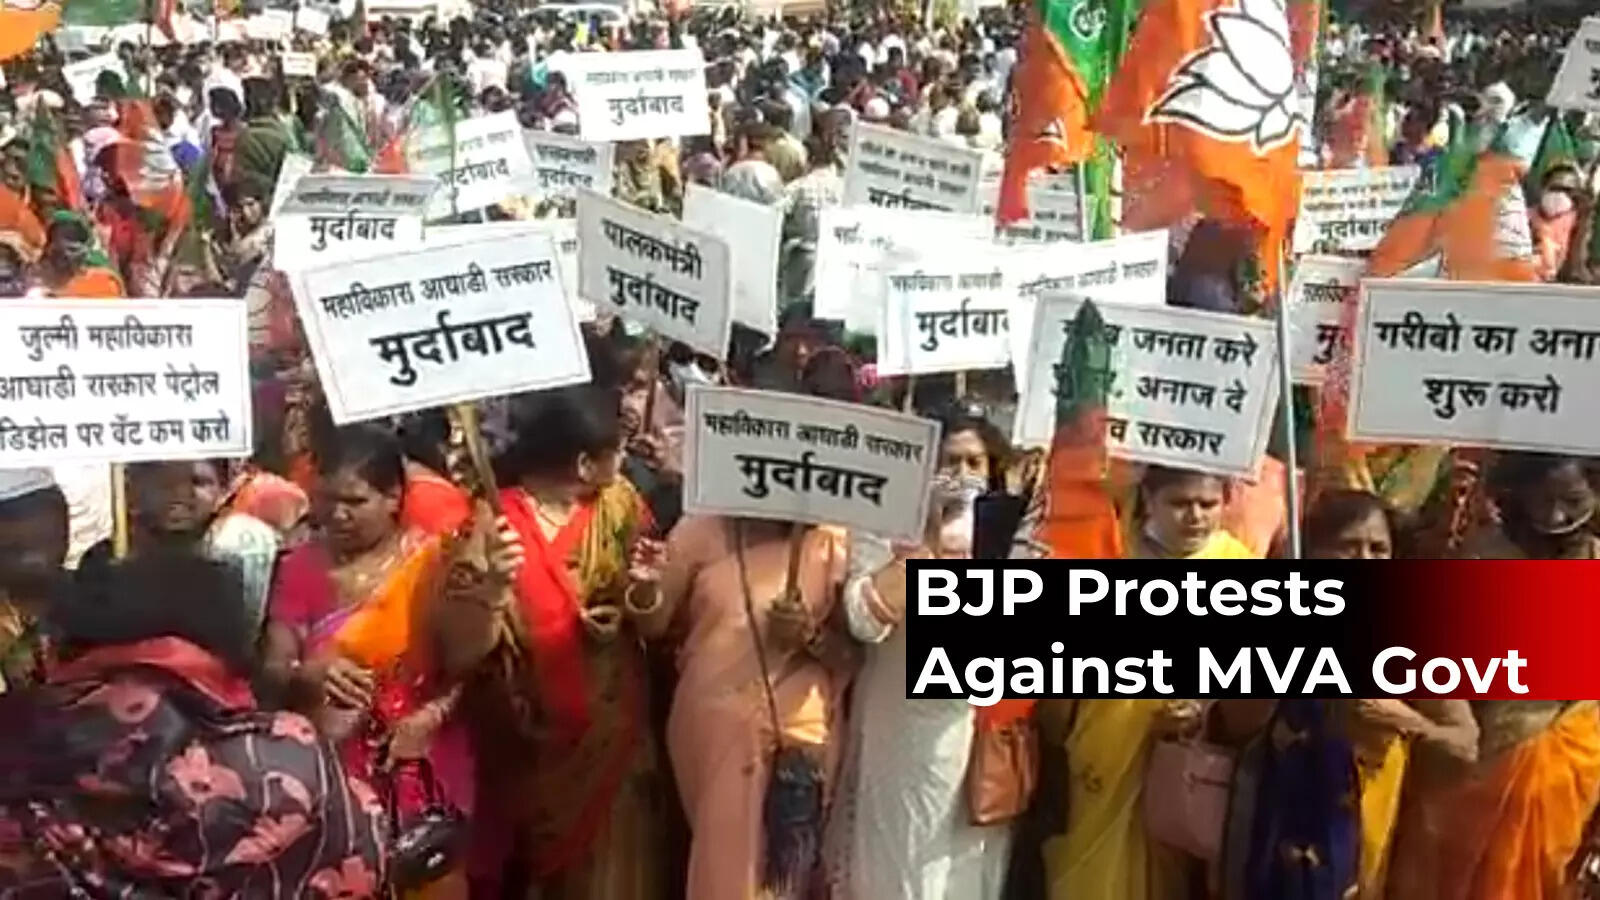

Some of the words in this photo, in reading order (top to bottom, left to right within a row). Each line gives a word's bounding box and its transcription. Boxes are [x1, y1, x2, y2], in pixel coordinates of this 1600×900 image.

[308, 208, 397, 251] मुर्दाबाद
[602, 217, 702, 280] पालकमंत्री
[606, 265, 700, 325] मुर्दाबाद
[369, 310, 535, 387] मुर्दाबाद
[1132, 327, 1207, 360] जनता
[1213, 331, 1258, 366] करे
[1471, 325, 1517, 355] का
[1528, 328, 1600, 360] अना
[163, 362, 219, 401] पेट्रोल
[1136, 375, 1216, 409] अनाज
[1224, 379, 1248, 413] दे
[1423, 376, 1491, 420] शुरू
[1498, 374, 1562, 413] करो
[76, 422, 103, 447] पर
[147, 420, 184, 443] कम
[189, 409, 230, 443] करो
[1136, 420, 1225, 455] सरकार
[735, 451, 888, 506] मुर्दाबाद
